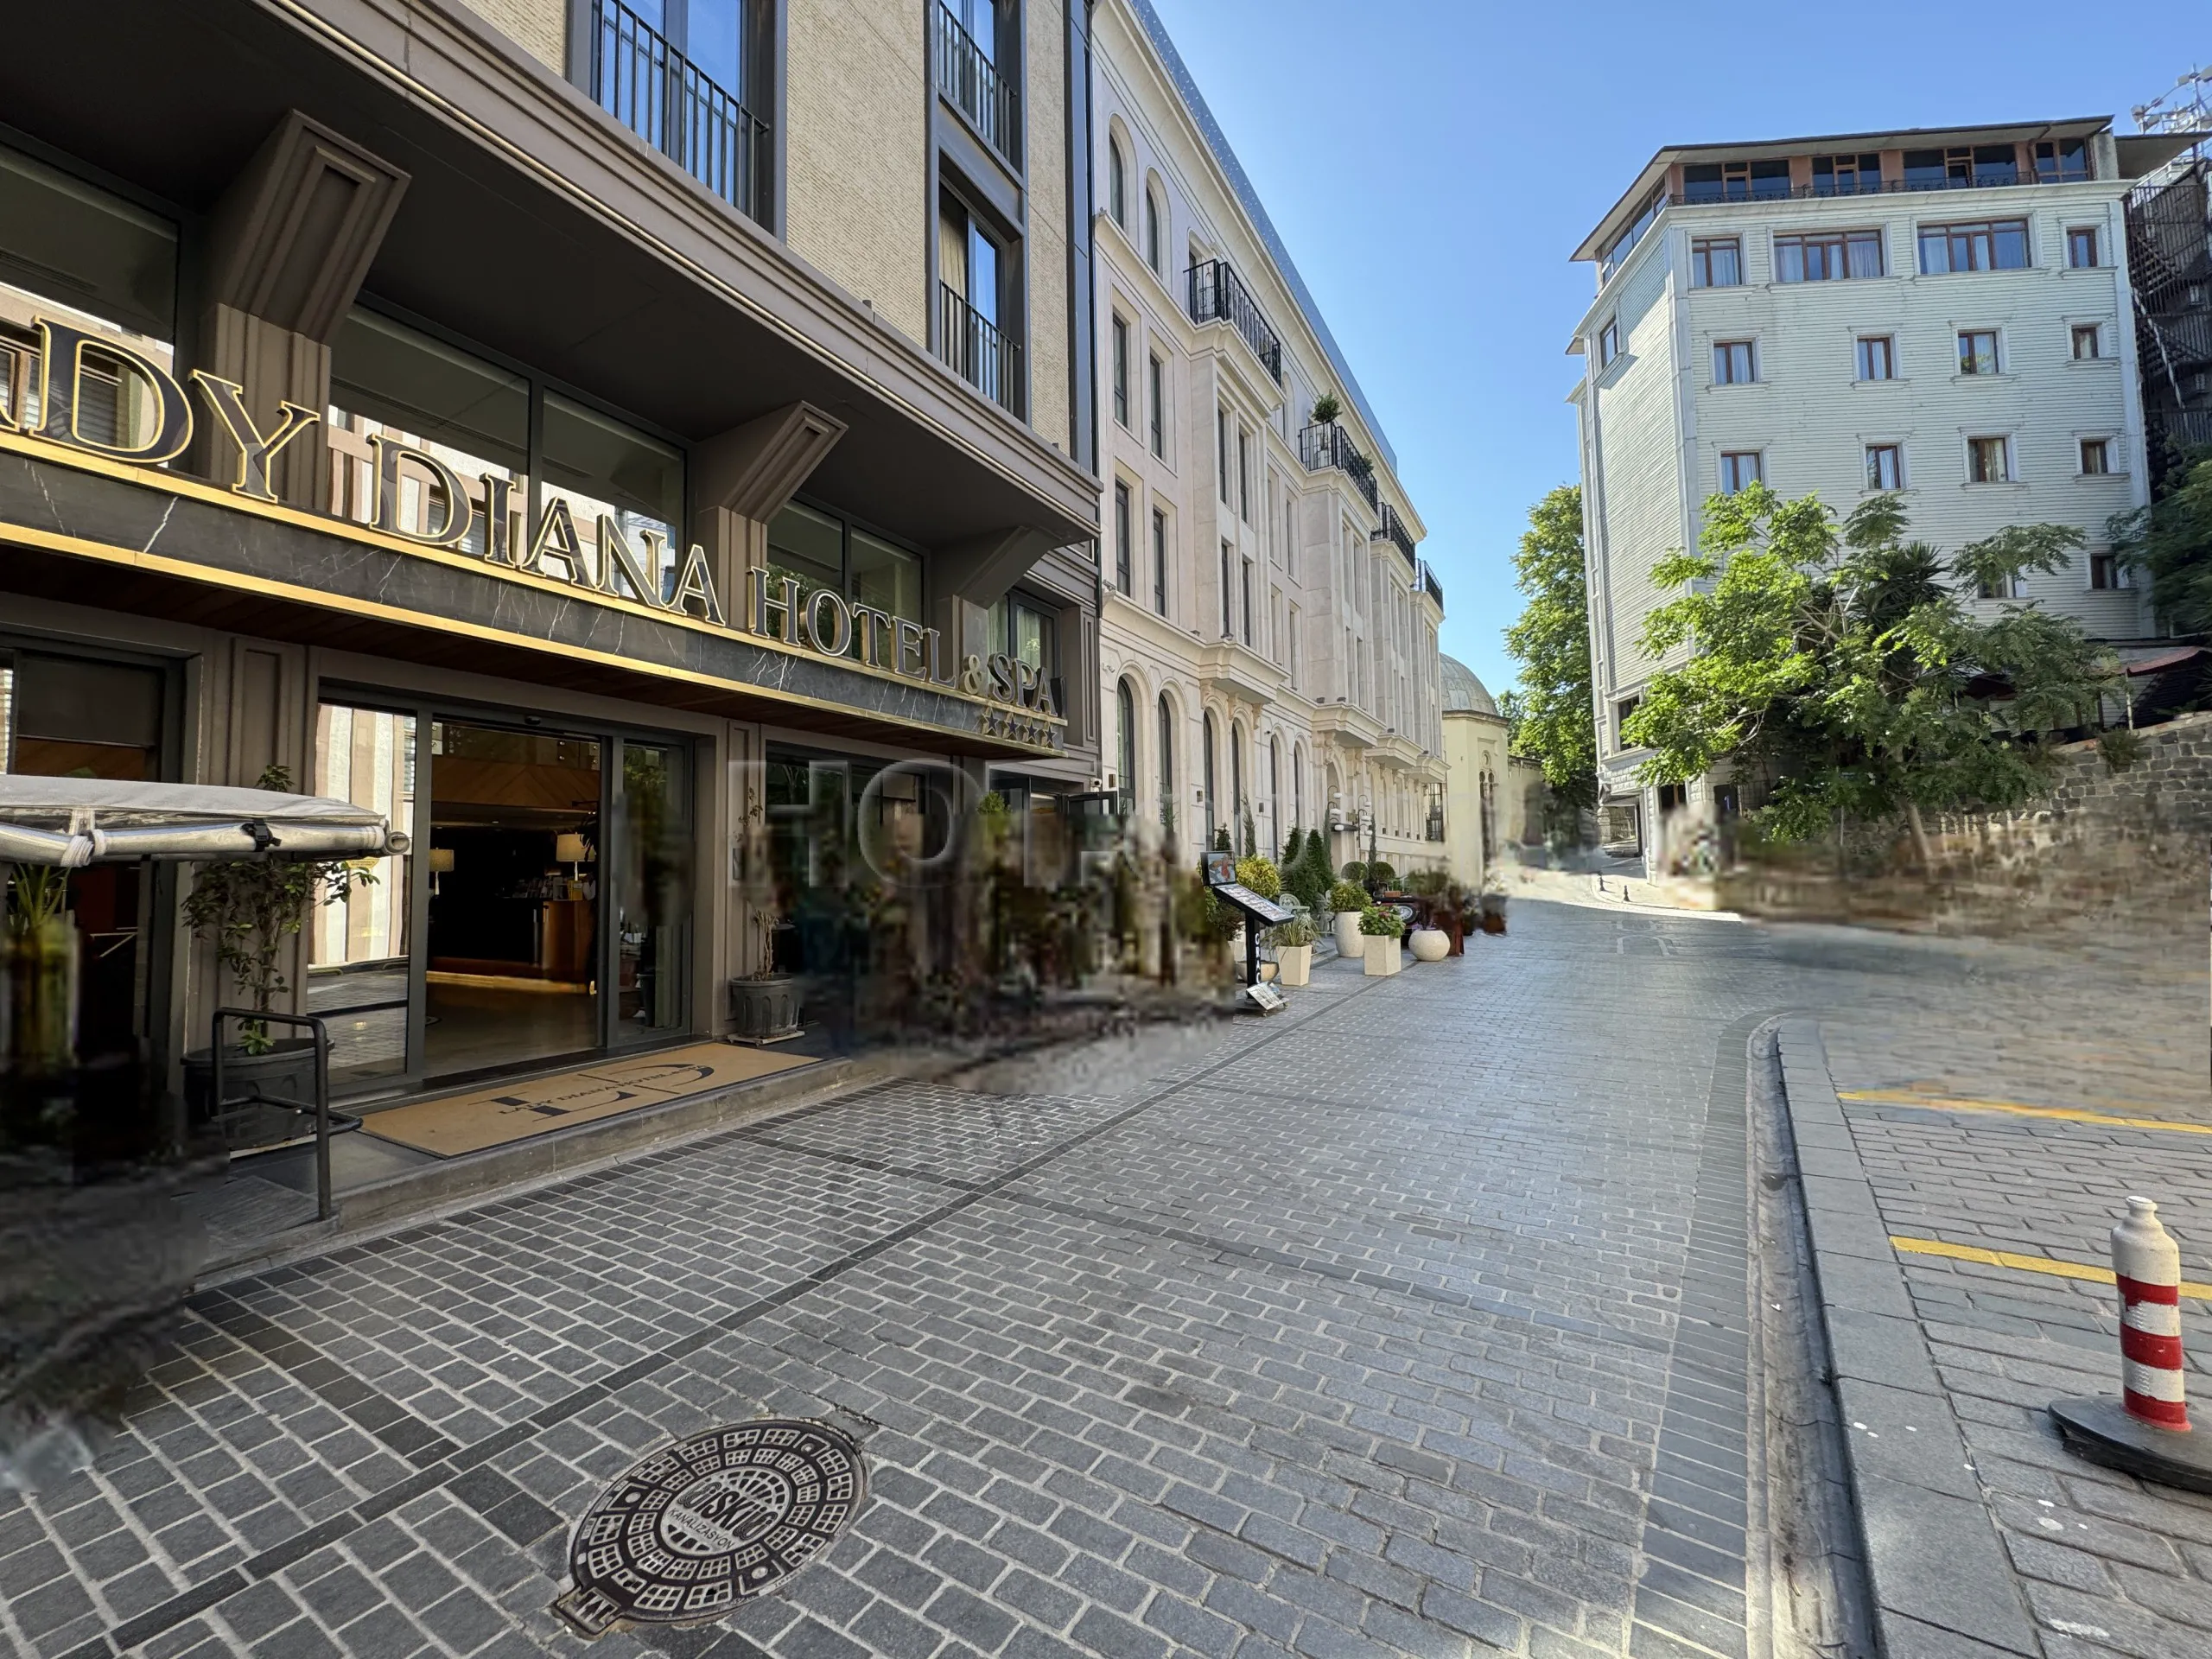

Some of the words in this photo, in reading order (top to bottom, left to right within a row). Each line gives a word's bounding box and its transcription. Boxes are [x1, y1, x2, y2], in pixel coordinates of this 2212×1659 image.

[0, 315, 321, 504] DY
[365, 433, 727, 627] DIANA
[747, 566, 957, 690] HOTEL
[959, 654, 983, 695] &
[988, 652, 1058, 717] SPA
